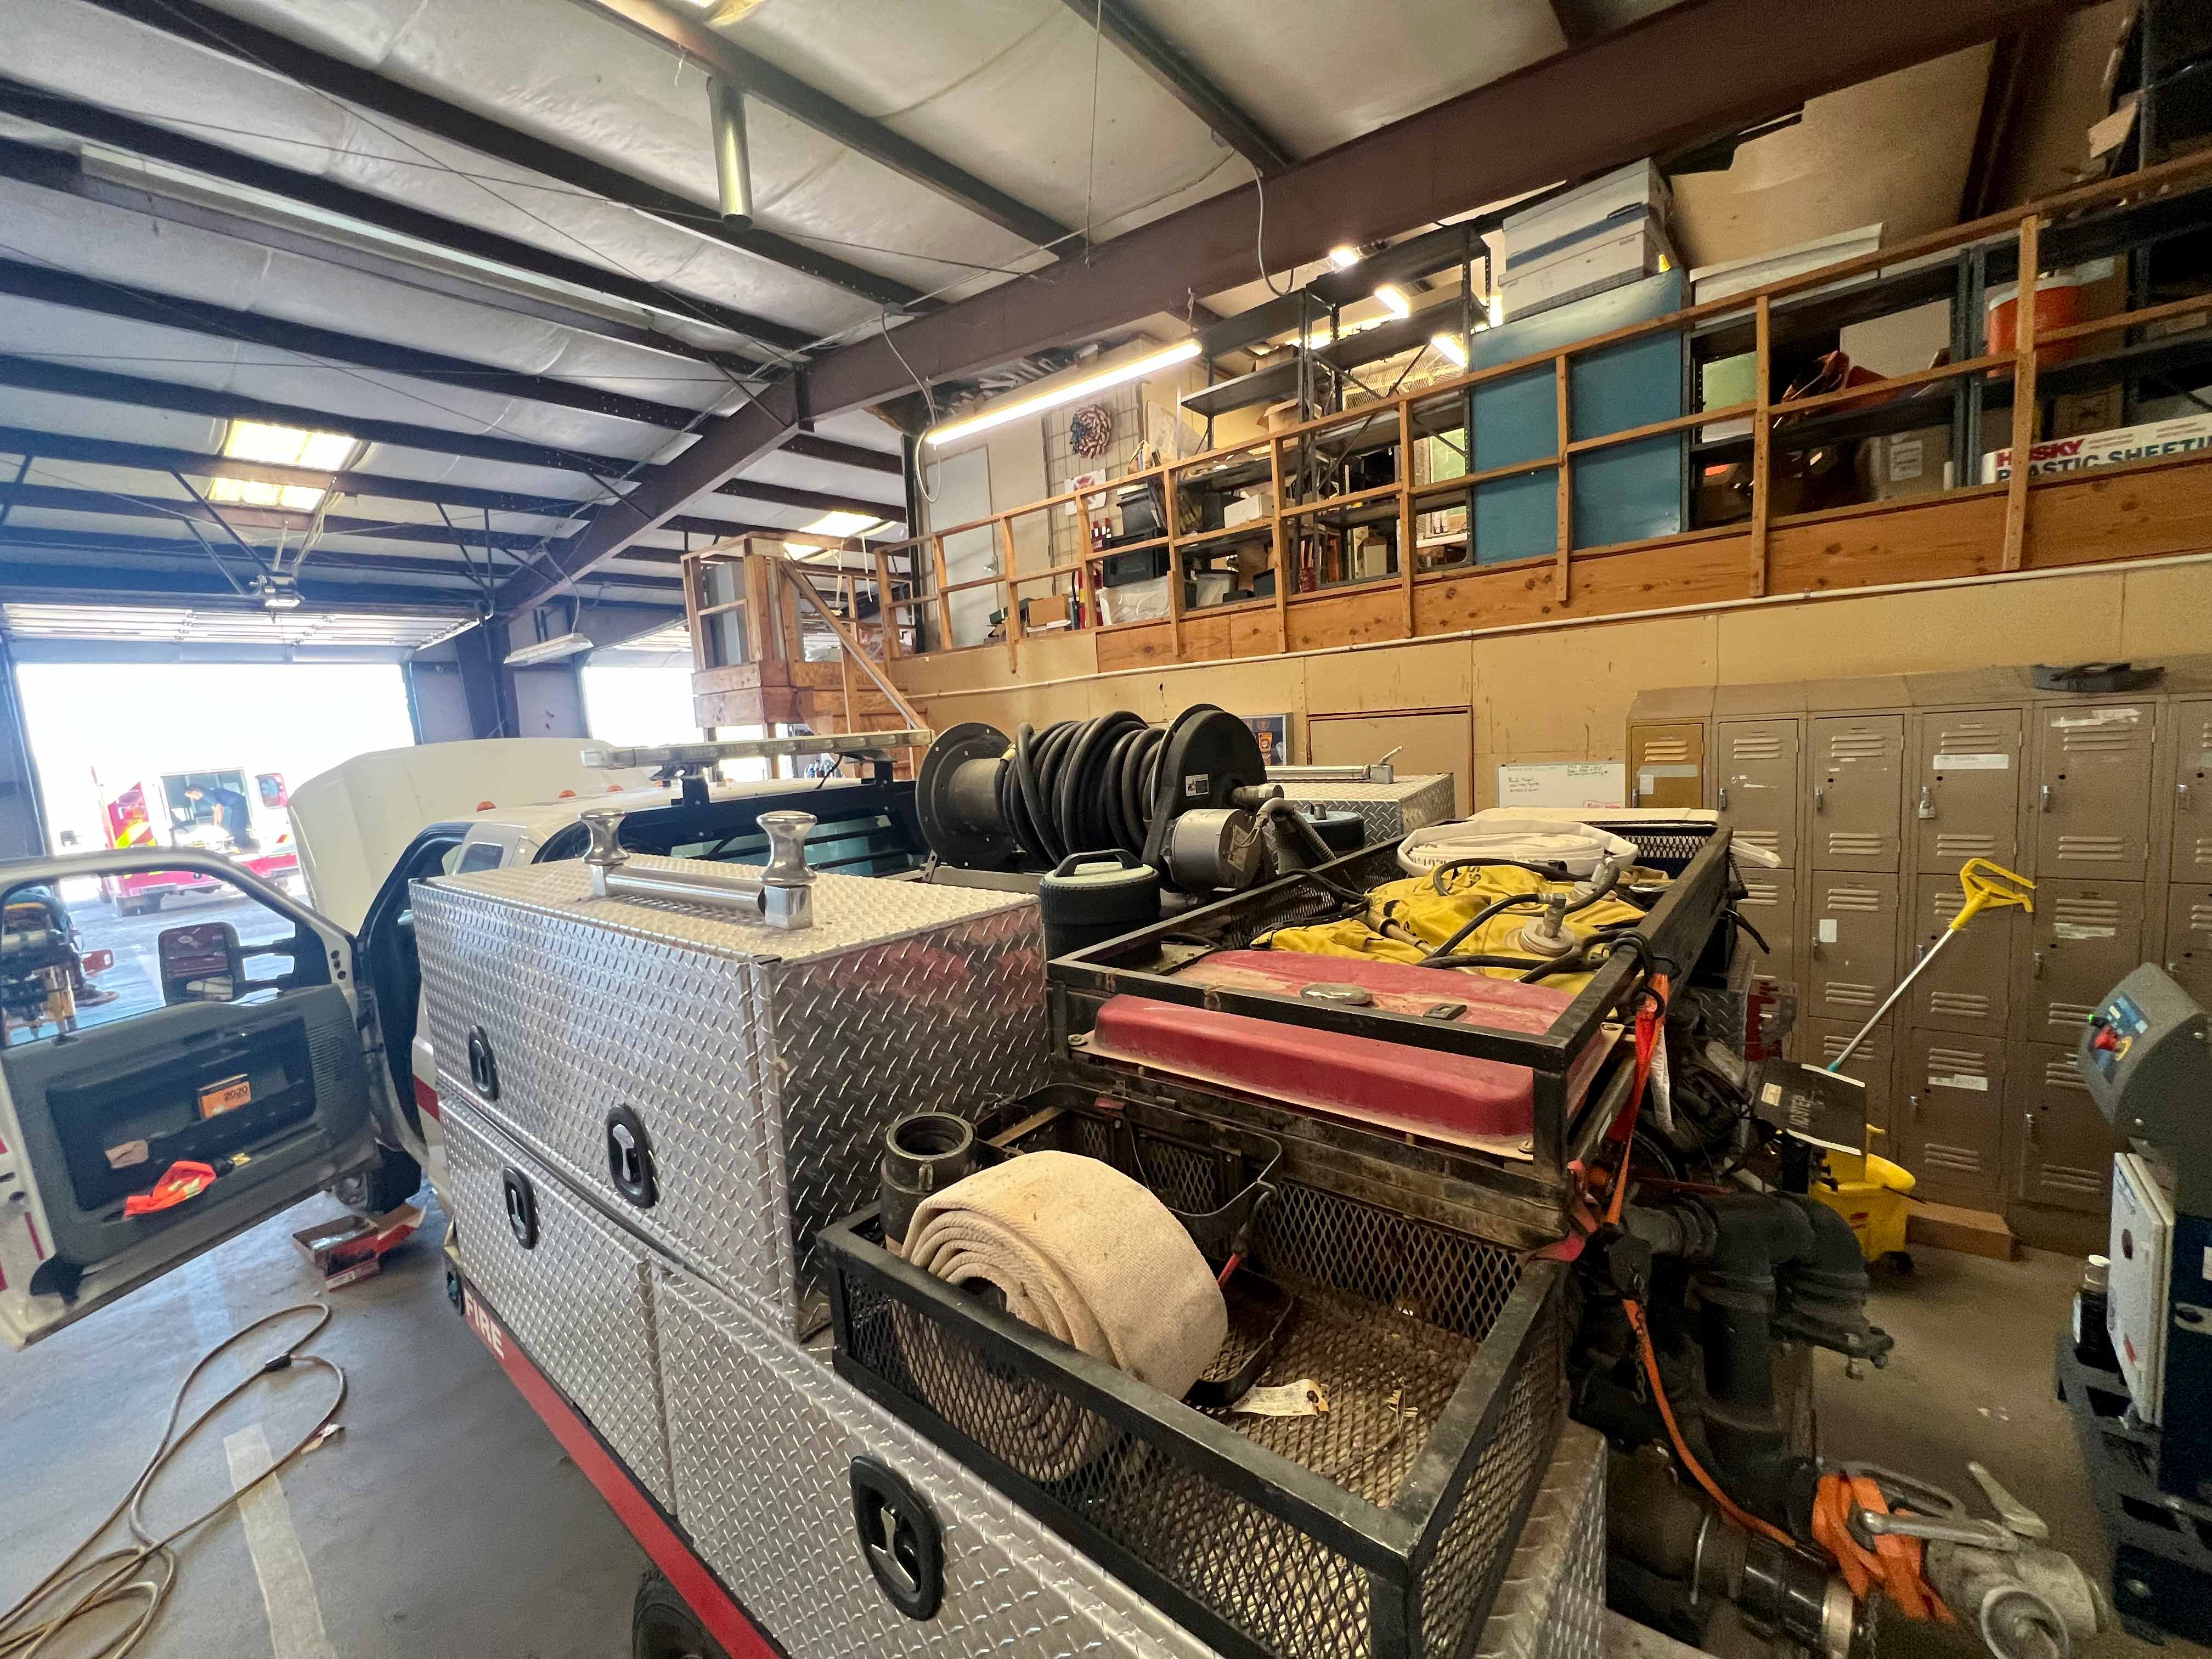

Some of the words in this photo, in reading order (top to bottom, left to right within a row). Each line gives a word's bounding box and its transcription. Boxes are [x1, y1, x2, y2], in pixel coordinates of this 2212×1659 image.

[1996, 438, 2084, 467] HSKY
[1997, 455, 2100, 479] PASTIC
[224, 1086, 248, 1102] 2020
[464, 1287, 505, 1359] FIRE
